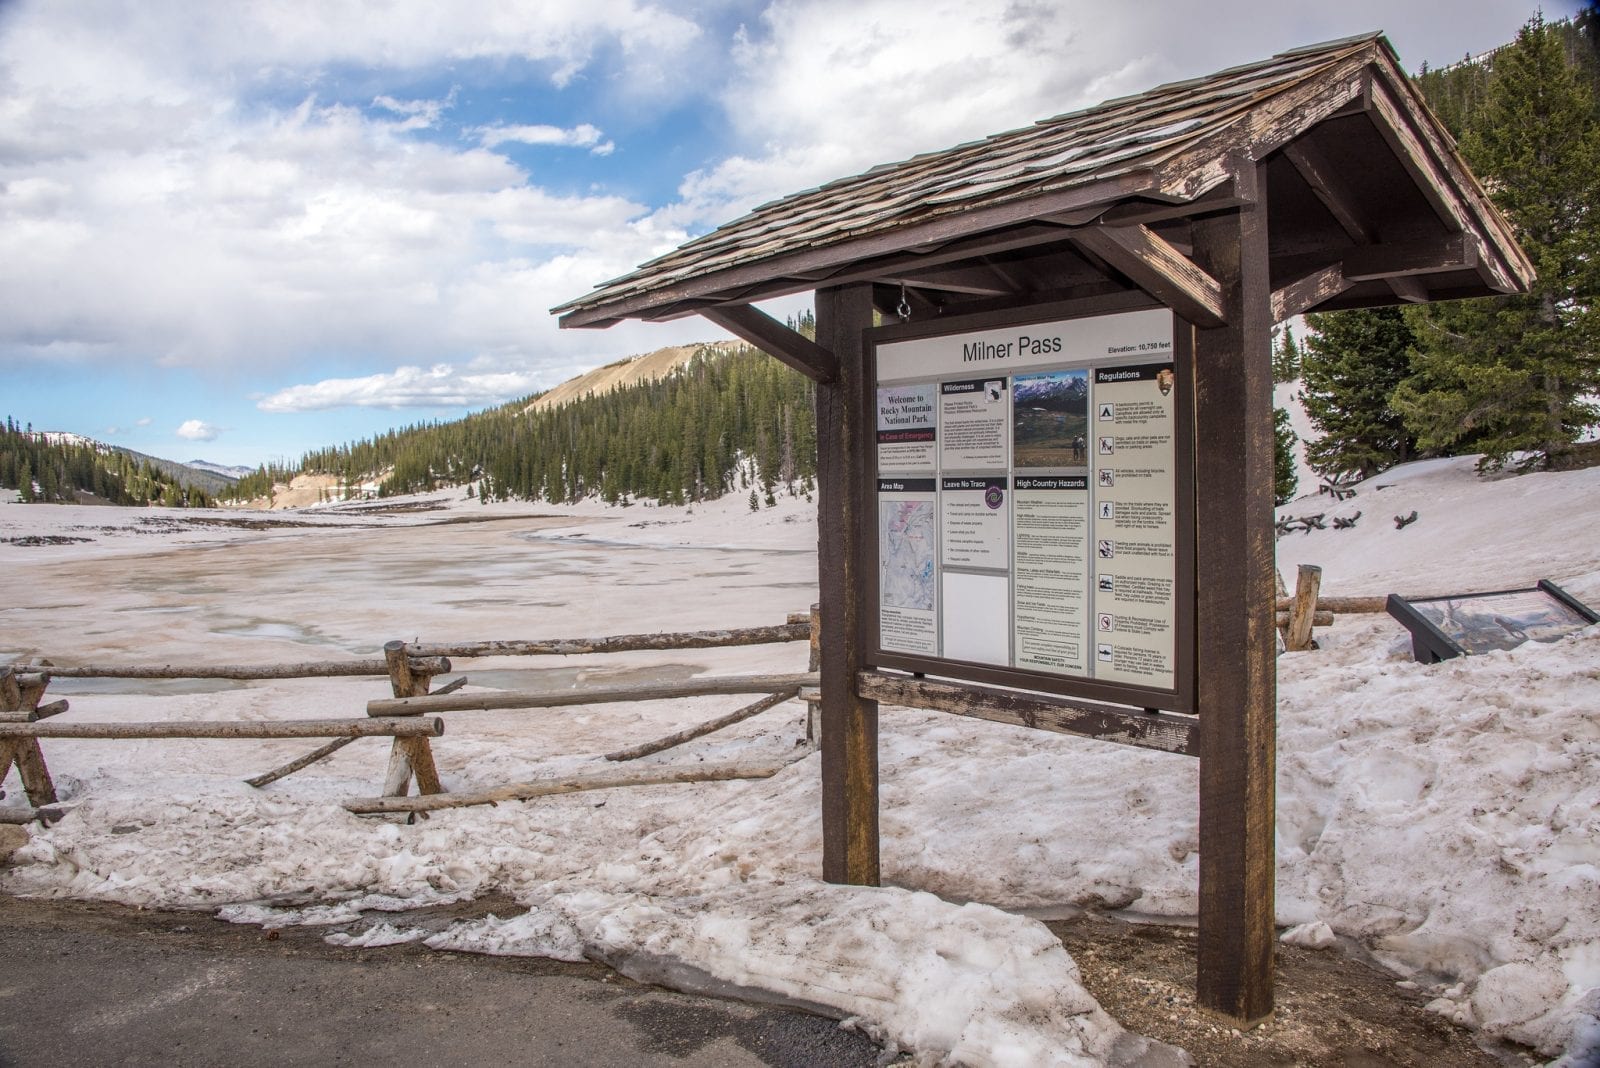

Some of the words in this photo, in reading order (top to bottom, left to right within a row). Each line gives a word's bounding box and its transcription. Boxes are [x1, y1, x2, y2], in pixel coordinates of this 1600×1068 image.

[963, 341, 1013, 362] Milner
[1018, 336, 1062, 355] Pass
[1108, 345, 1137, 354] Elevation:
[1138, 342, 1158, 351] 10,750
[1158, 341, 1171, 349] feet
[1098, 371, 1140, 382] Regulations
[943, 383, 975, 392] Wilderness
[888, 395, 917, 404] Welcome
[917, 395, 924, 403] to
[880, 405, 899, 416] Rocky
[901, 403, 932, 413] Mountain
[885, 415, 911, 425] National
[912, 414, 928, 423] Park
[905, 431, 934, 441] Emergency
[881, 482, 893, 490] Area
[893, 482, 904, 491] Map
[943, 480, 960, 488] Leave
[960, 480, 970, 488] No
[970, 480, 986, 488] Trace
[1016, 479, 1032, 488] High
[1032, 479, 1057, 488] Country
[1058, 479, 1085, 487] Hazards
